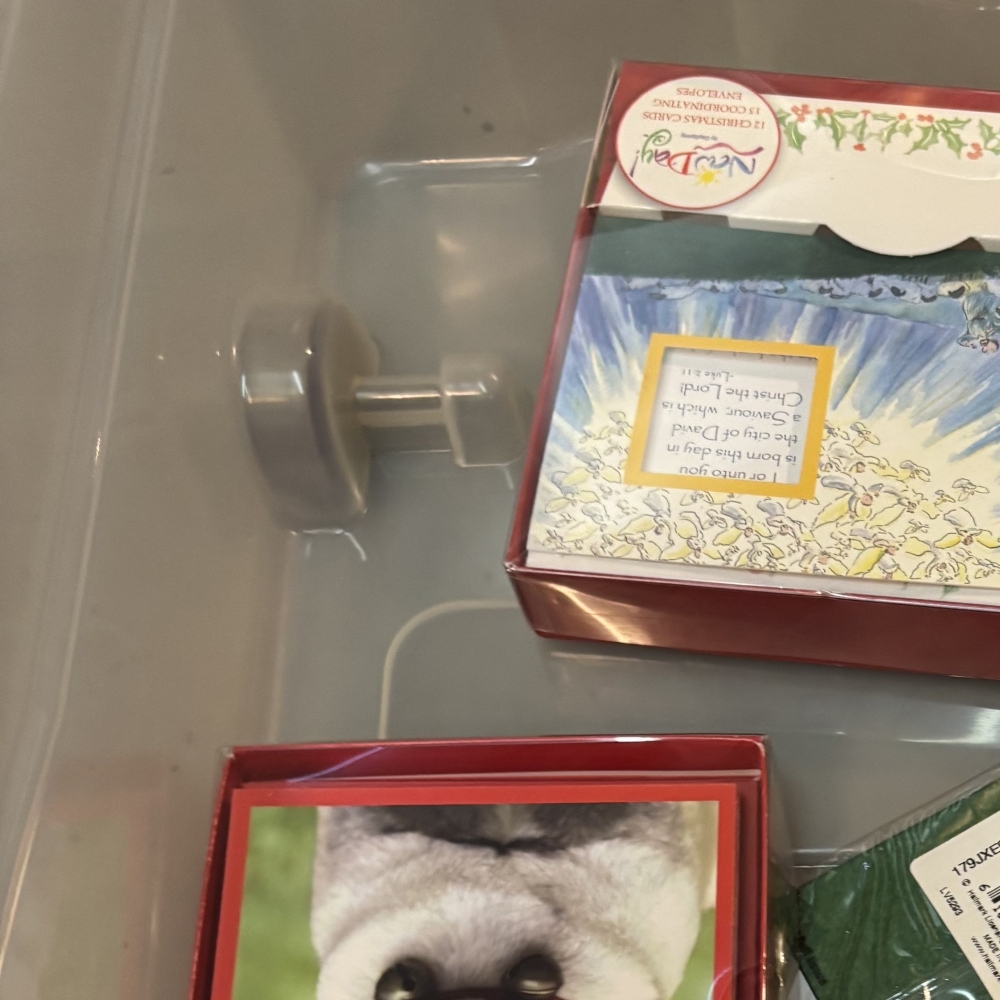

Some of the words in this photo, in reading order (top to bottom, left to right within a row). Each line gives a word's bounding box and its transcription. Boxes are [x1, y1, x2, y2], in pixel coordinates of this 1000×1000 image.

[675, 87, 743, 100] ENVELOPES
[652, 98, 747, 114] COORDINATING
[642, 111, 681, 122] CARDS
[684, 115, 752, 128] CHRISTMAS
[754, 120, 766, 129] 12
[680, 382, 722, 400] Lord!
[725, 388, 749, 402] the
[753, 390, 803, 408] Christ
[661, 401, 674, 412] is
[677, 402, 717, 419] which
[793, 413, 802, 423] a
[671, 423, 719, 442] David
[722, 429, 740, 442] of
[743, 426, 770, 442] city
[774, 433, 798, 447] the
[666, 444, 680, 455] in
[683, 441, 712, 460] day
[715, 449, 742, 463] this
[746, 451, 781, 466] born
[785, 454, 797, 466] is
[678, 463, 708, 477] you
[711, 469, 746, 482] unto
[978, 883, 991, 892] 6
[983, 933, 1000, 954] MADE
